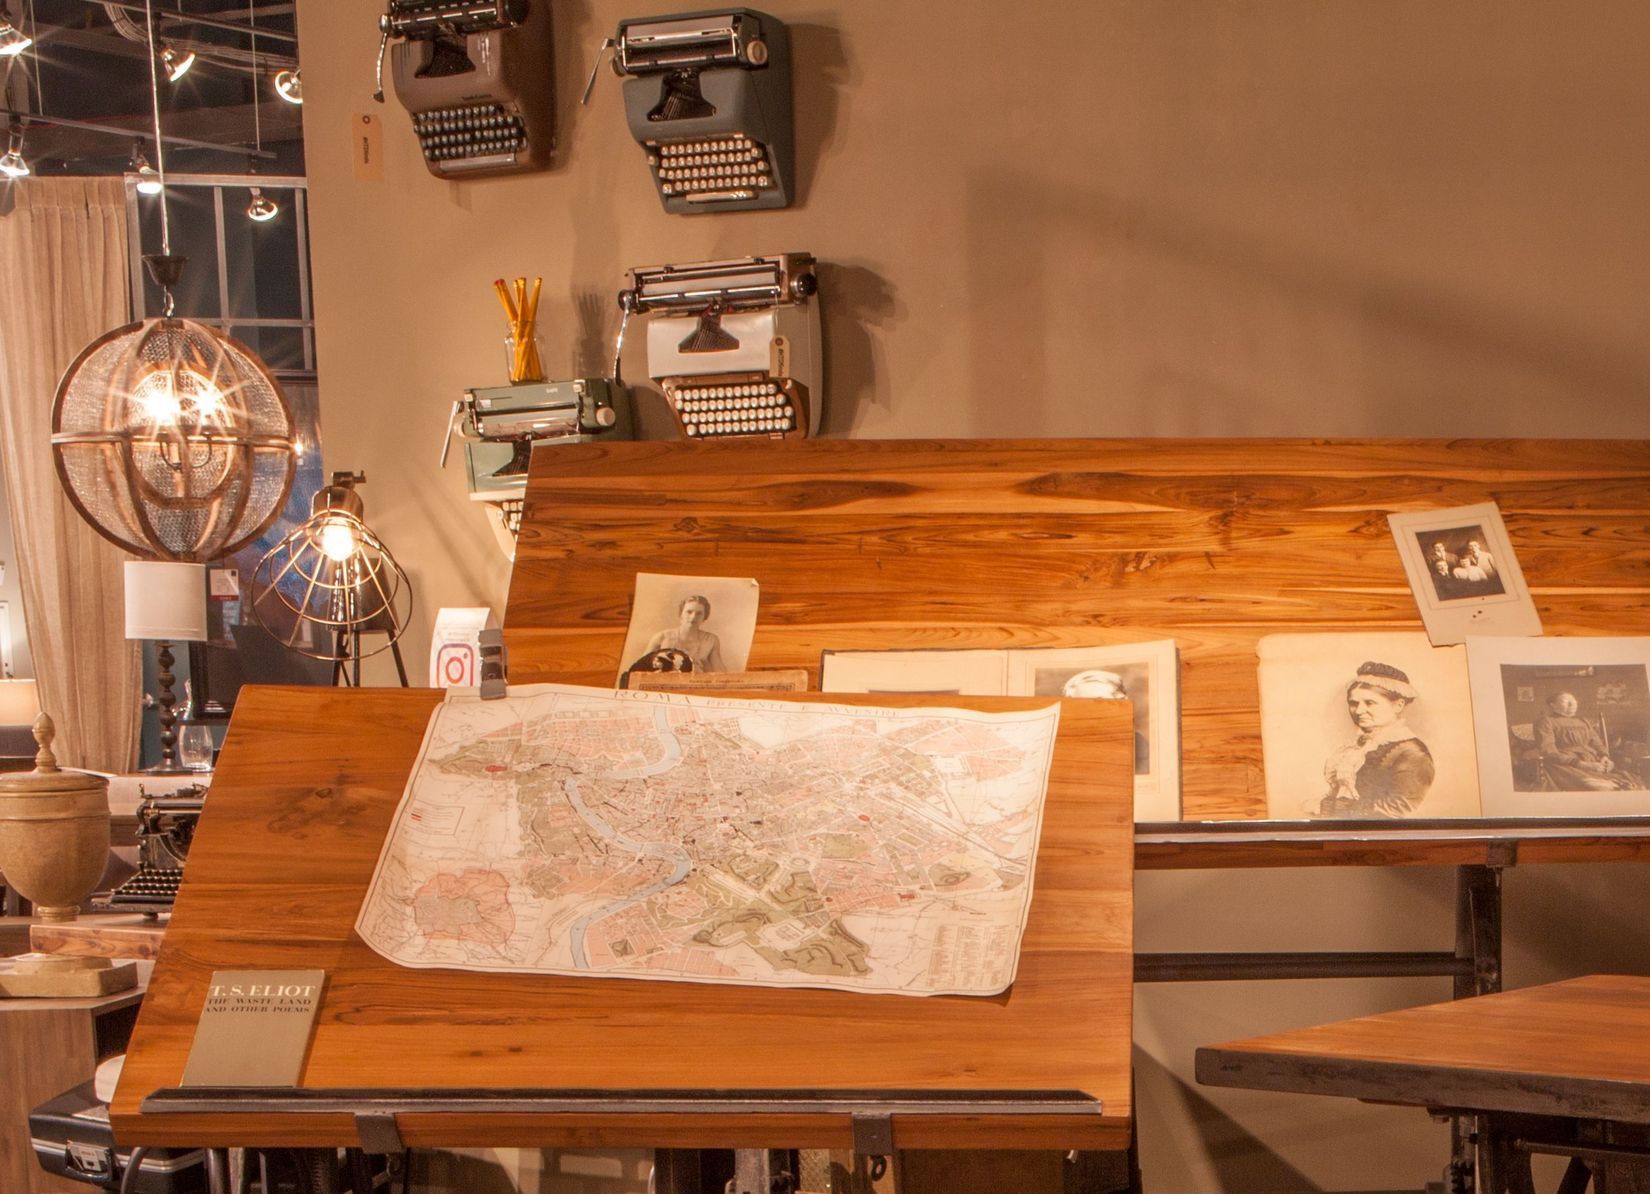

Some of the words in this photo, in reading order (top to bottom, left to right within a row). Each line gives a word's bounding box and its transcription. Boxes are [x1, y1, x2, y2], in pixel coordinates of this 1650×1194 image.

[229, 984, 244, 997] S.
[249, 984, 316, 998] ELIOT
[207, 998, 228, 1006] THE
[235, 998, 272, 1006] WASTE
[279, 998, 312, 1006] LAND
